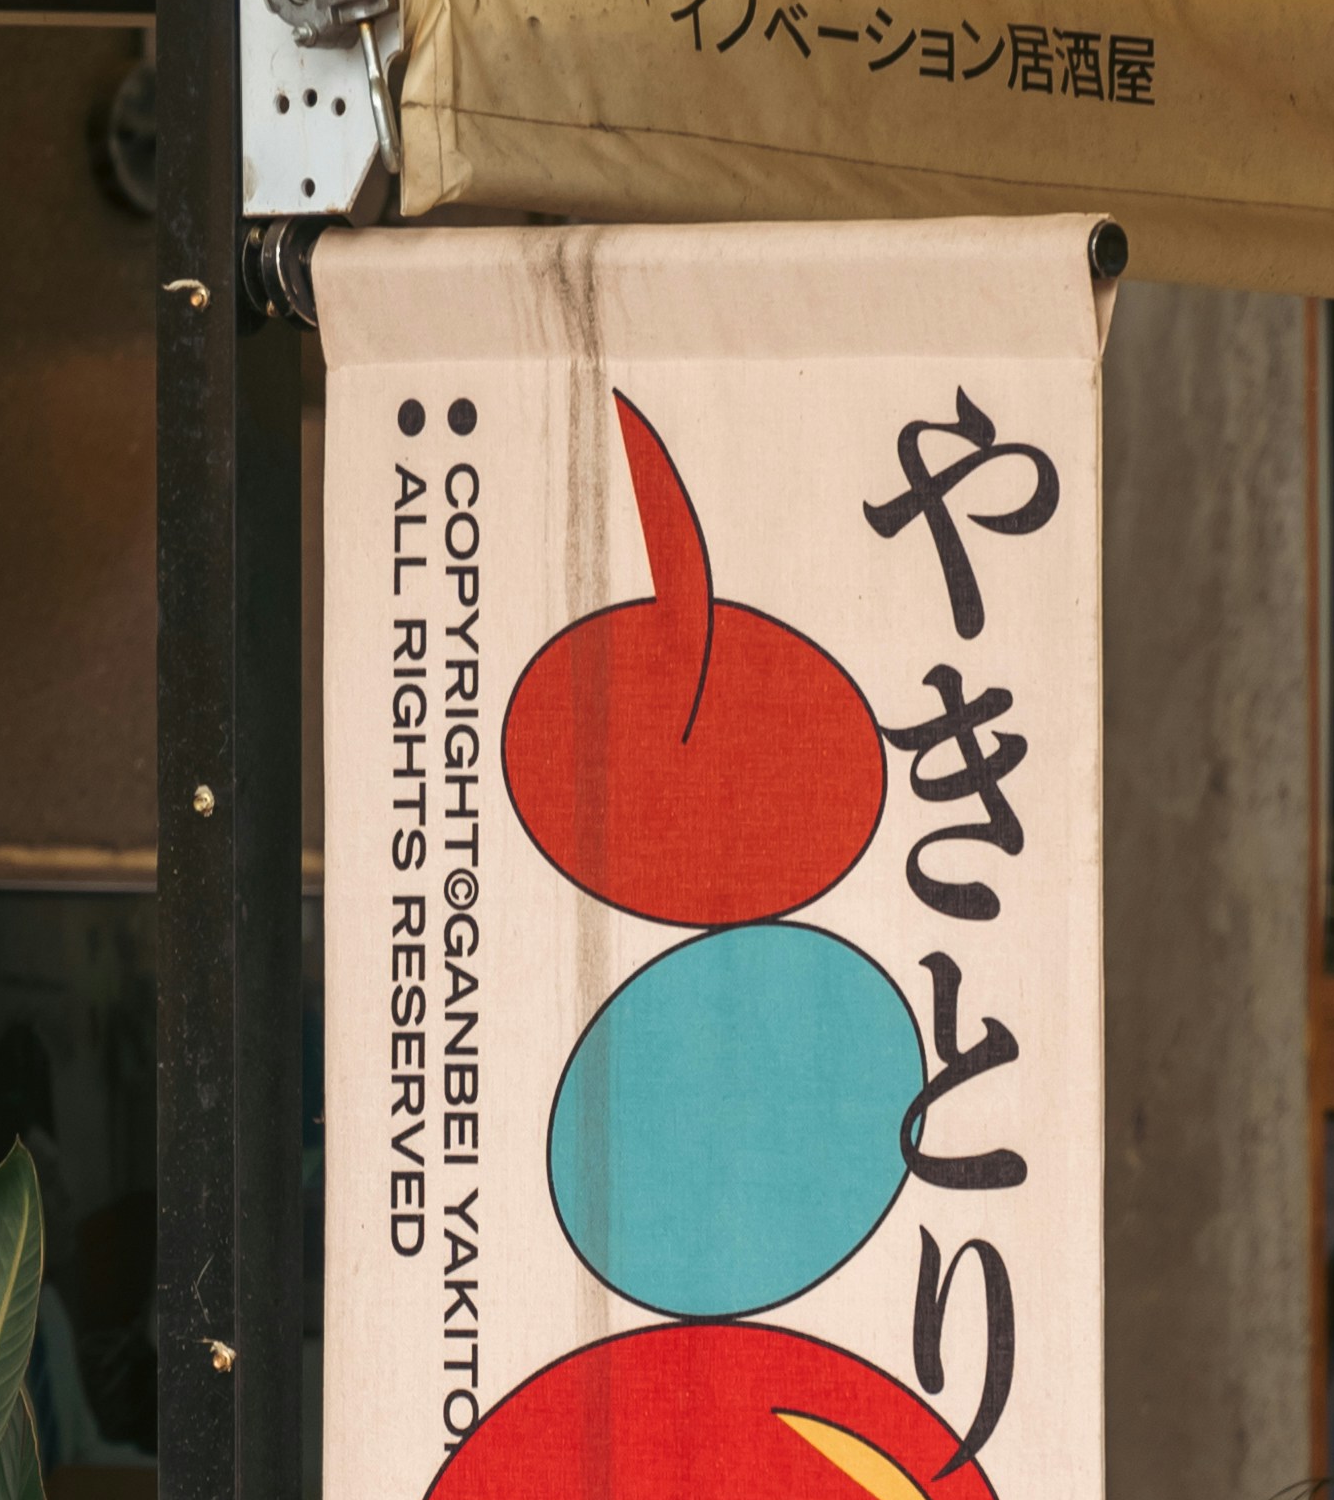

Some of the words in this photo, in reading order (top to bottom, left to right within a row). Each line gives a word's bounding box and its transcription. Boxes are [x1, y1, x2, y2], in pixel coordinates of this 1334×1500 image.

[394, 463, 427, 596] ALL
[392, 619, 427, 871] RIGHTS
[862, 384, 1061, 1482] やきとり
[390, 895, 426, 1258] RESERVED
[443, 1186, 479, 1453] YAKITO
